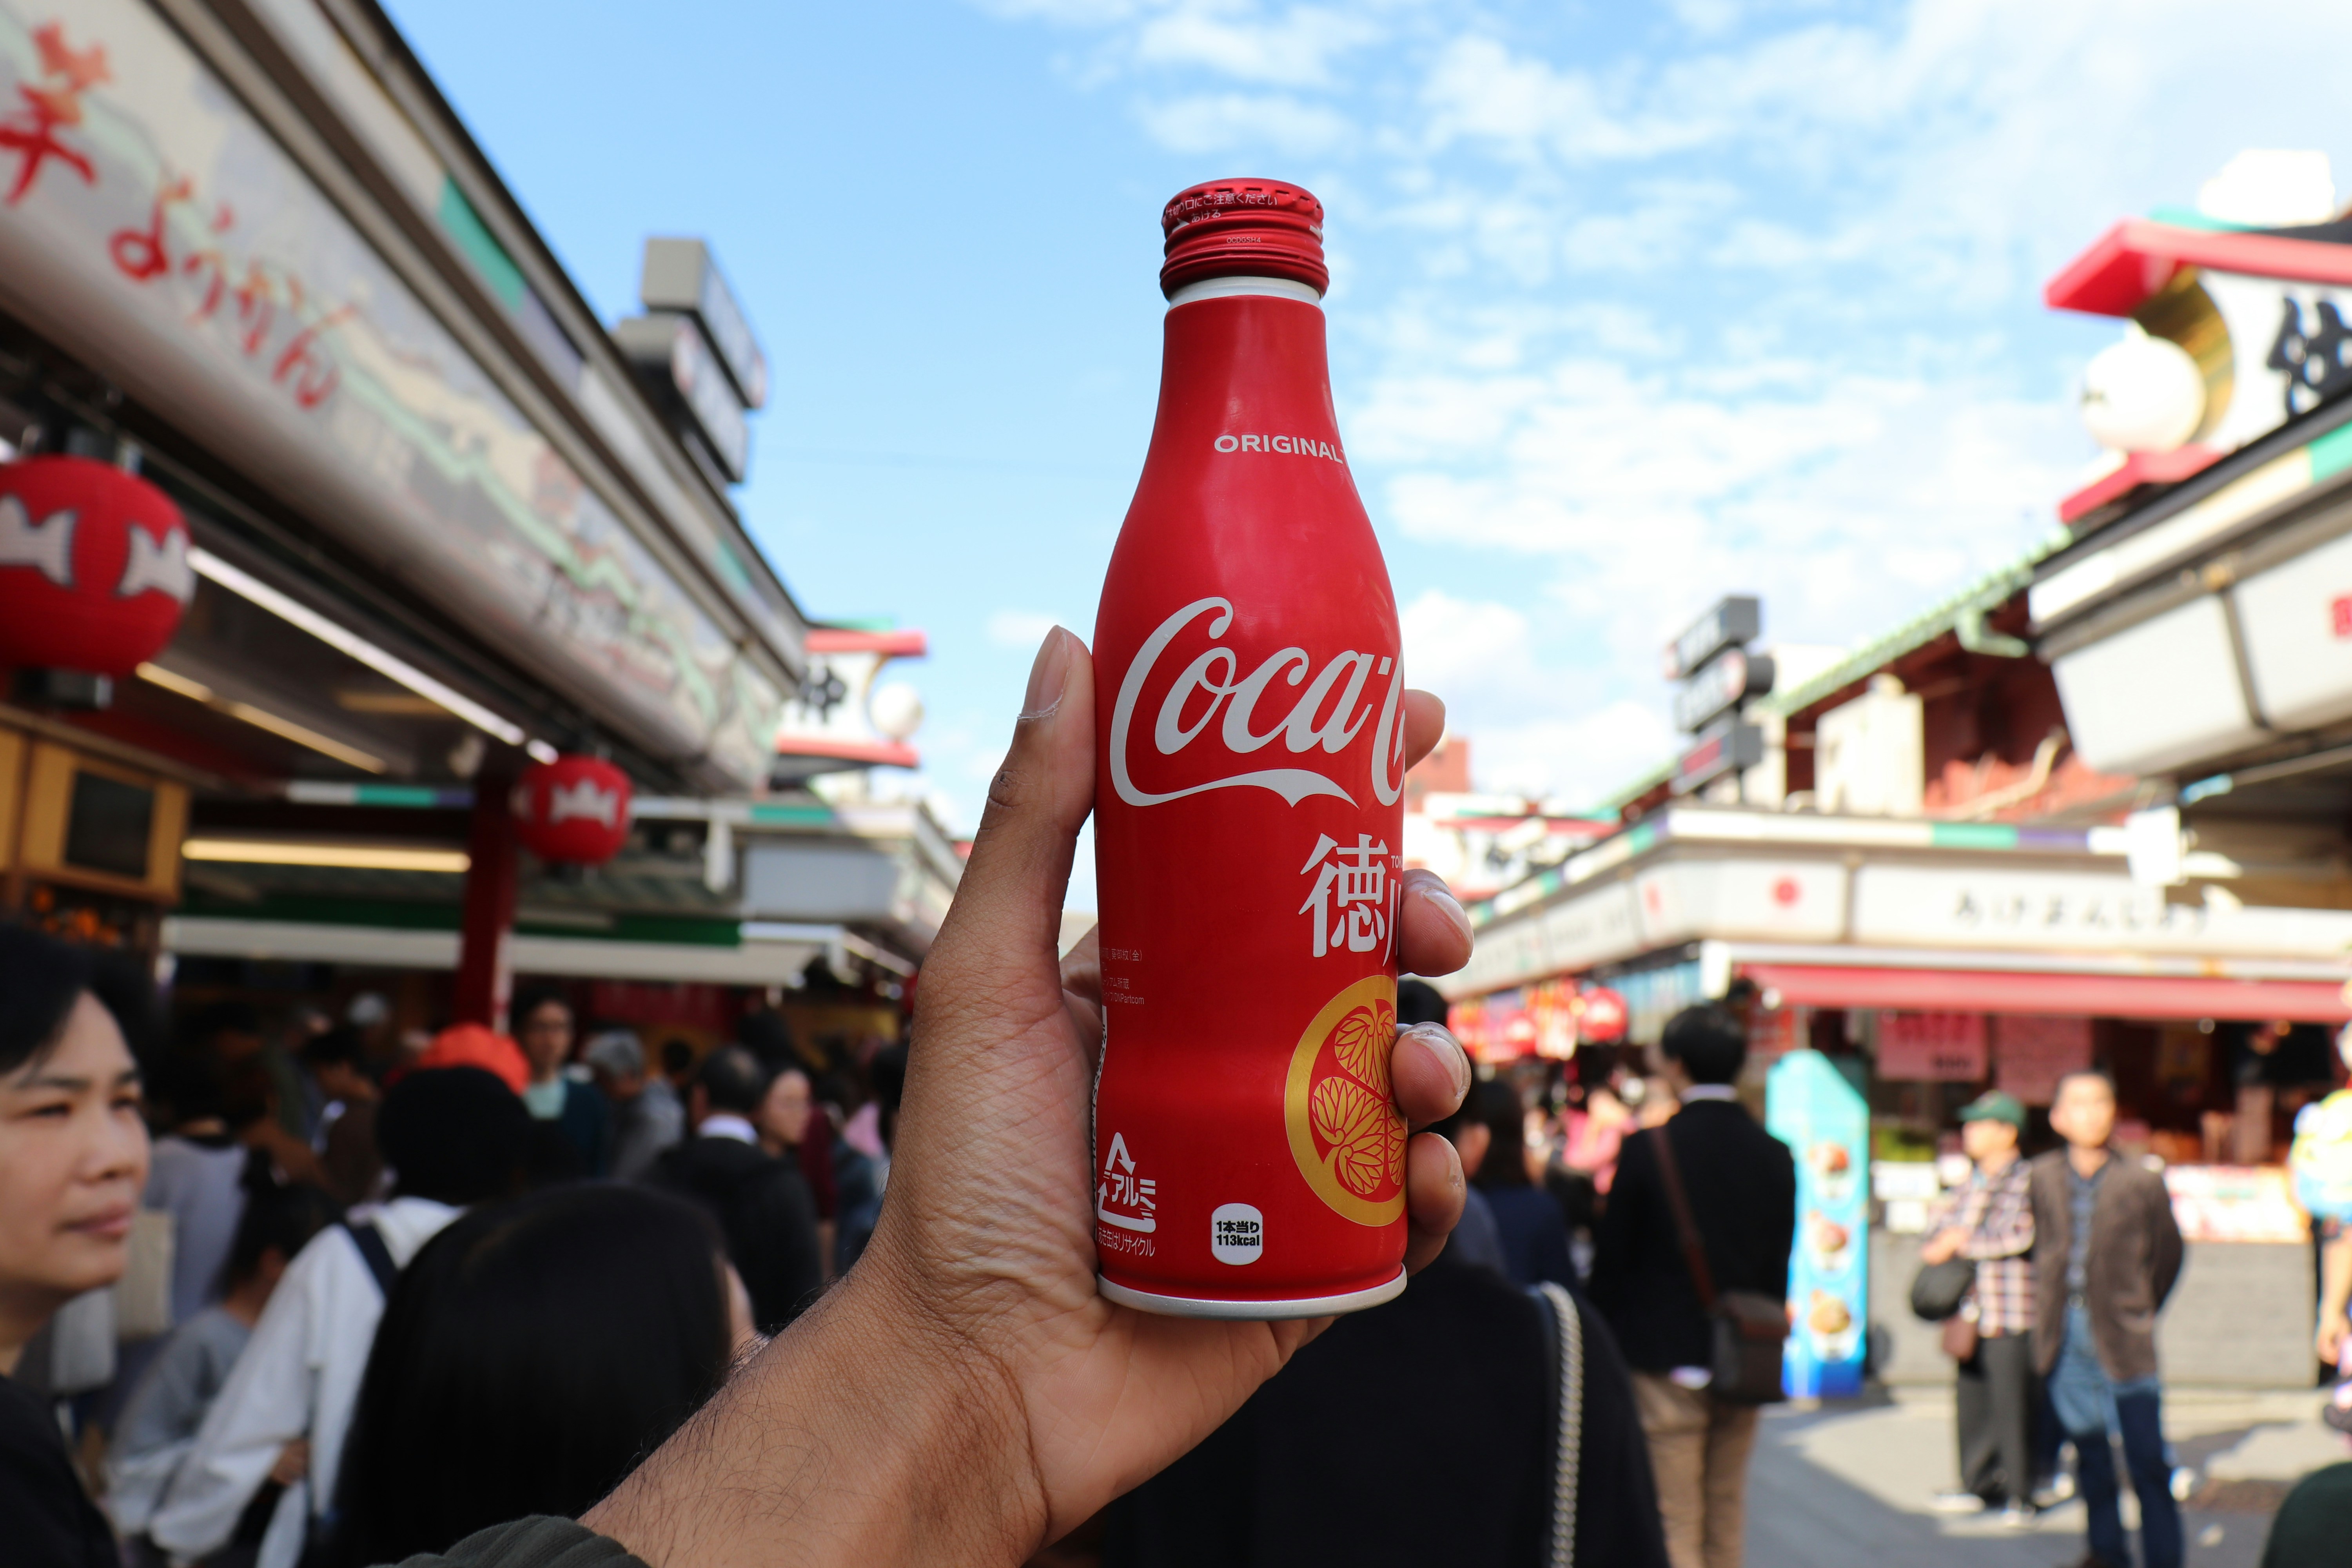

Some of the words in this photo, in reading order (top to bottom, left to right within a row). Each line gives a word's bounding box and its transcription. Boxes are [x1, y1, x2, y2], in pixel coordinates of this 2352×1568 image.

[1191, 209, 1221, 223] あける
[1214, 435, 1343, 464] ORIGINAL
[1110, 597, 1405, 809] Coca-C
[1112, 1173, 1156, 1210] アルミ
[1216, 1221, 1259, 1233] 1本当り
[1216, 1235, 1259, 1246] 113kcal
